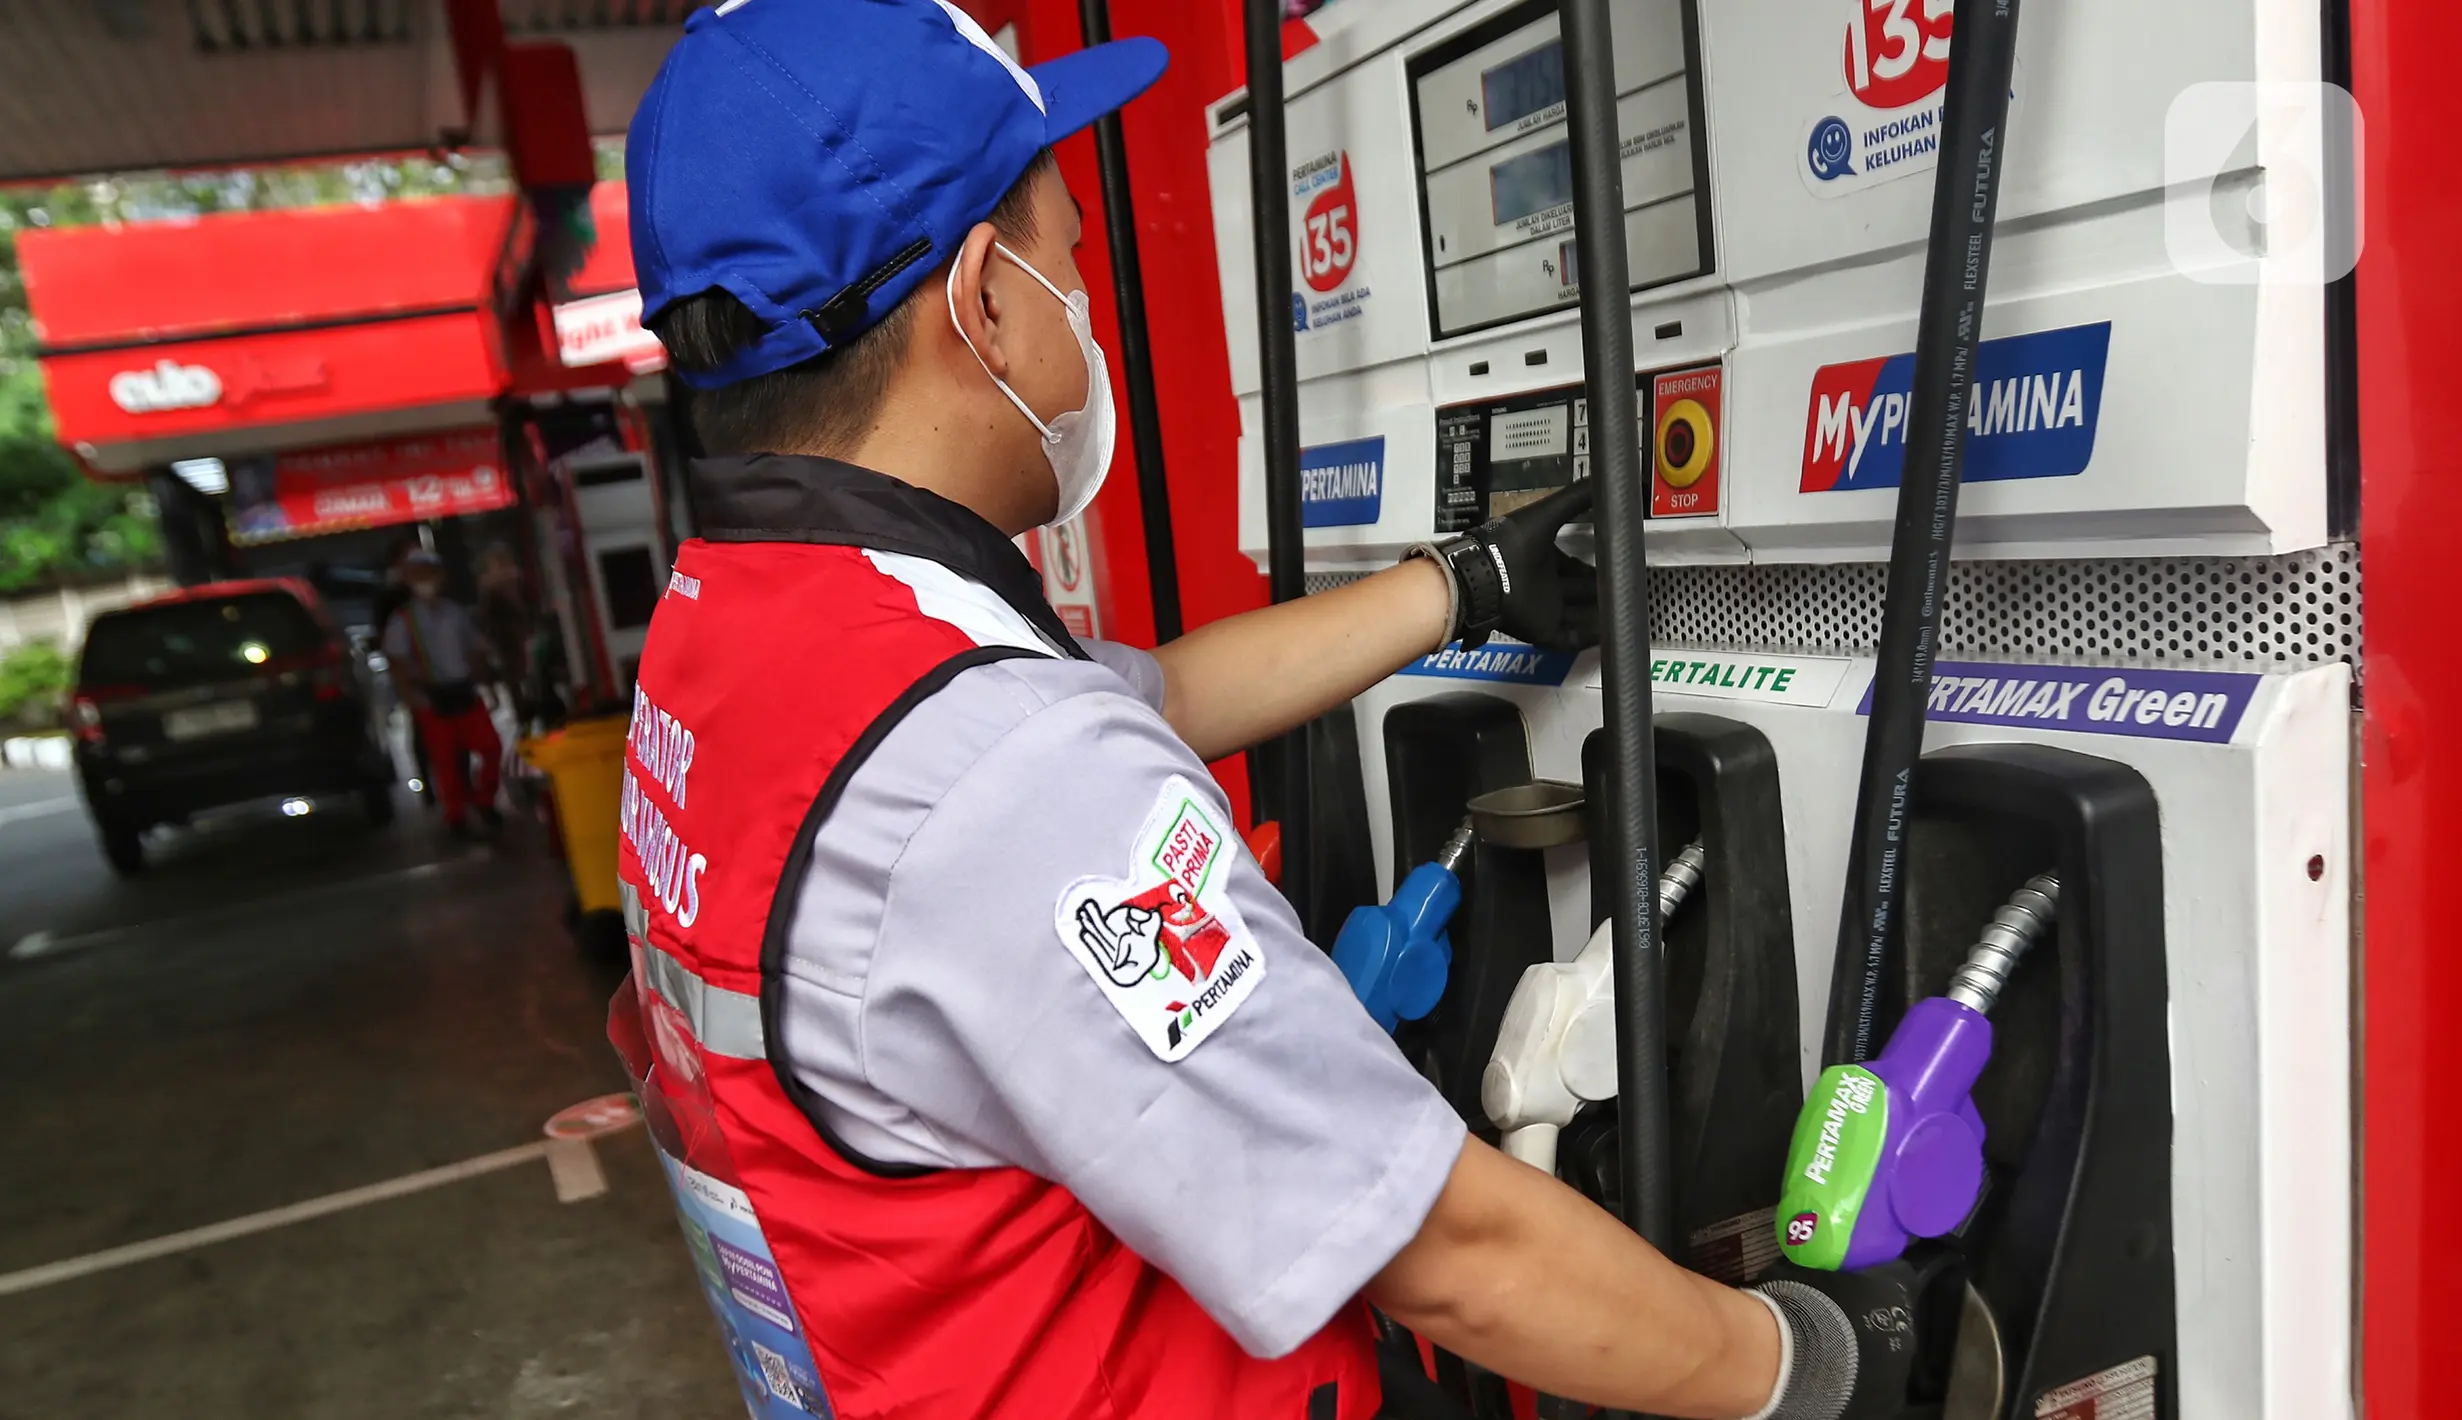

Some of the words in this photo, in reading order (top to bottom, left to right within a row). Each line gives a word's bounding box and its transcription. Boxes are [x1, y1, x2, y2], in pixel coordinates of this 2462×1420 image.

[1543, 105, 1565, 123] HARGA
[1863, 111, 1933, 149] INFOKAN
[1293, 150, 1338, 182] PERTAMINA
[1865, 134, 1937, 172] KELUHAN
[1972, 126, 1996, 223] FUTURA
[1301, 204, 1353, 279] 135
[1530, 221, 1551, 235] DALAM
[1542, 259, 1555, 277] Rp
[1964, 233, 1983, 290] FLEXSTEEL
[1659, 374, 1718, 396] EMERGENCY
[1578, 403, 1586, 421] 7
[1578, 432, 1586, 450] 4
[1301, 461, 1377, 502] PERTAMINA
[1671, 493, 1699, 508] STOP
[1488, 543, 1511, 594] UNDEFEATED
[1422, 648, 1544, 676] PERTAMAX
[1650, 659, 1797, 693] ERTALITE
[2085, 676, 2230, 730] Green
[1887, 767, 1910, 842] FUTURA
[1162, 818, 1200, 873] PASTI
[1181, 831, 1215, 895] PRIMA
[1878, 847, 1897, 893] FLEXSTEEL
[1192, 948, 1255, 1018] PERTAMINA
[1803, 1071, 1861, 1186] PERTAMAX
[1787, 1218, 1815, 1241] 95
